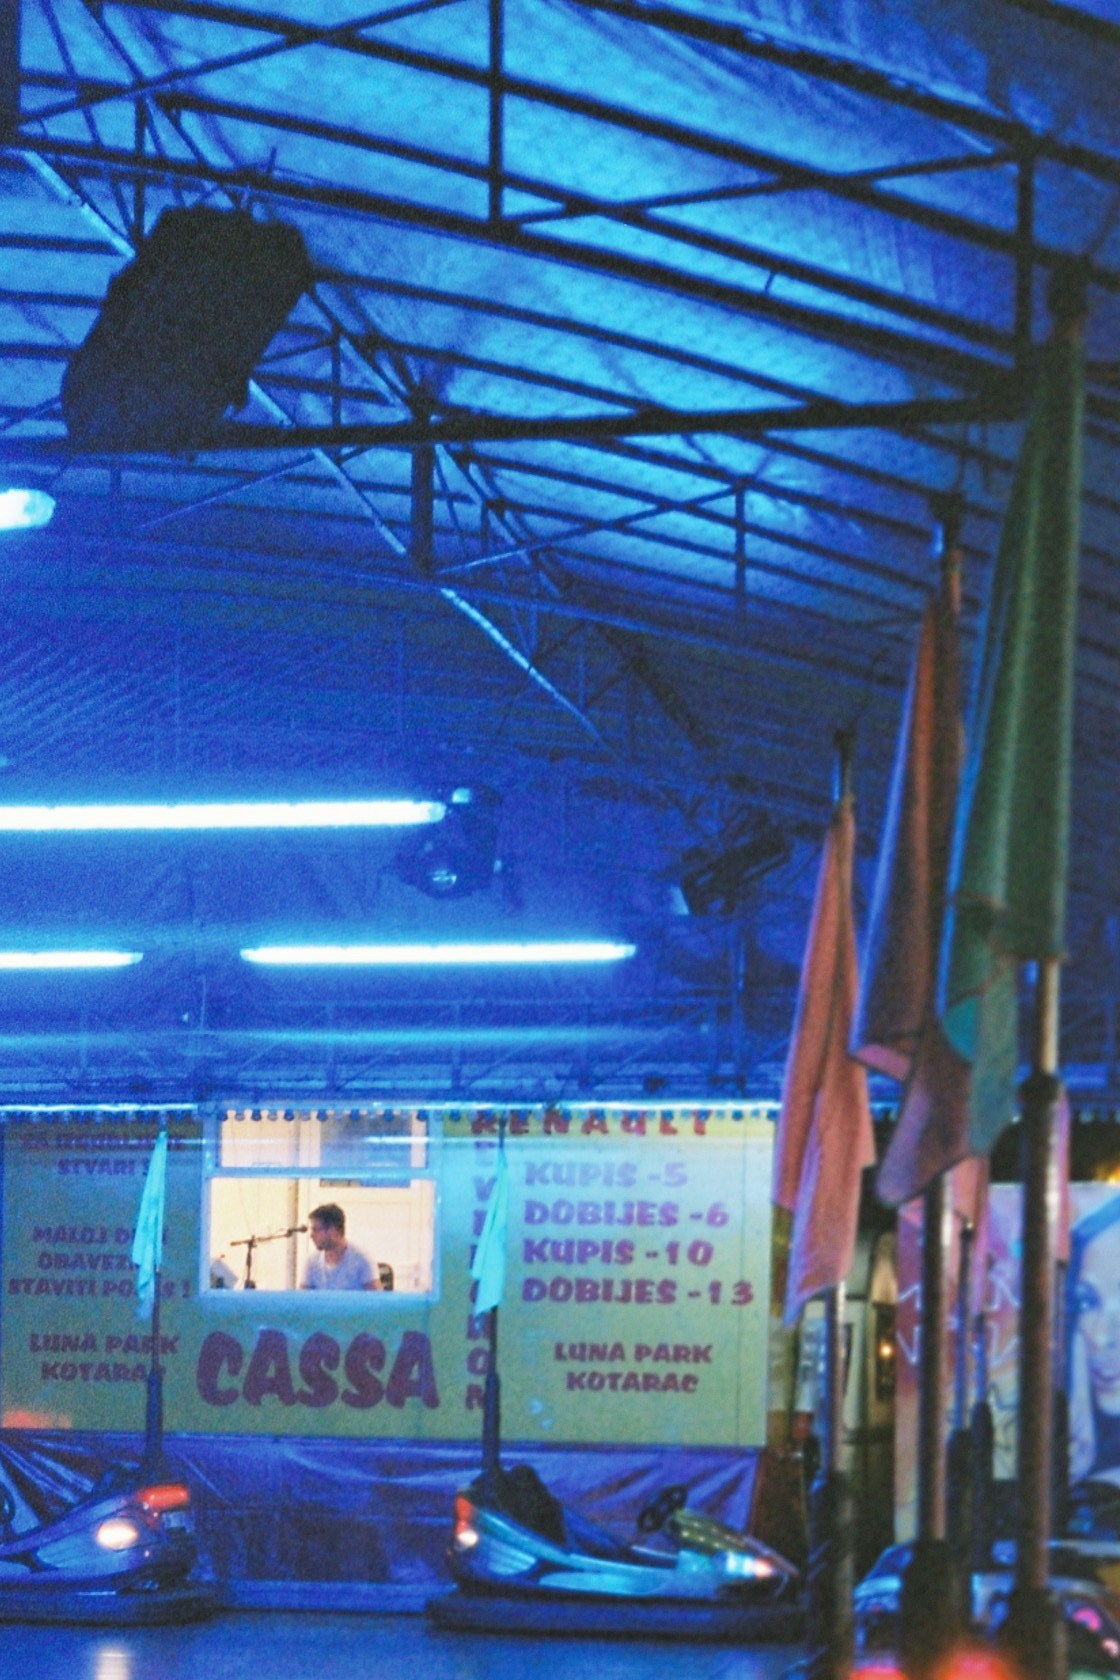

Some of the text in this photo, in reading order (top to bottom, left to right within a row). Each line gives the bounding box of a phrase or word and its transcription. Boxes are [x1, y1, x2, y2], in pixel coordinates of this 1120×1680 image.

[525, 1162, 637, 1187] KUPIS
[524, 1200, 679, 1227] DOBIJES
[523, 1239, 635, 1265] KUPIS
[522, 1277, 677, 1305] DOBIJES
[30, 1333, 179, 1353] LUNA PARK
[554, 1341, 712, 1365] LUNA PARK
[196, 1329, 440, 1409] CASSA
